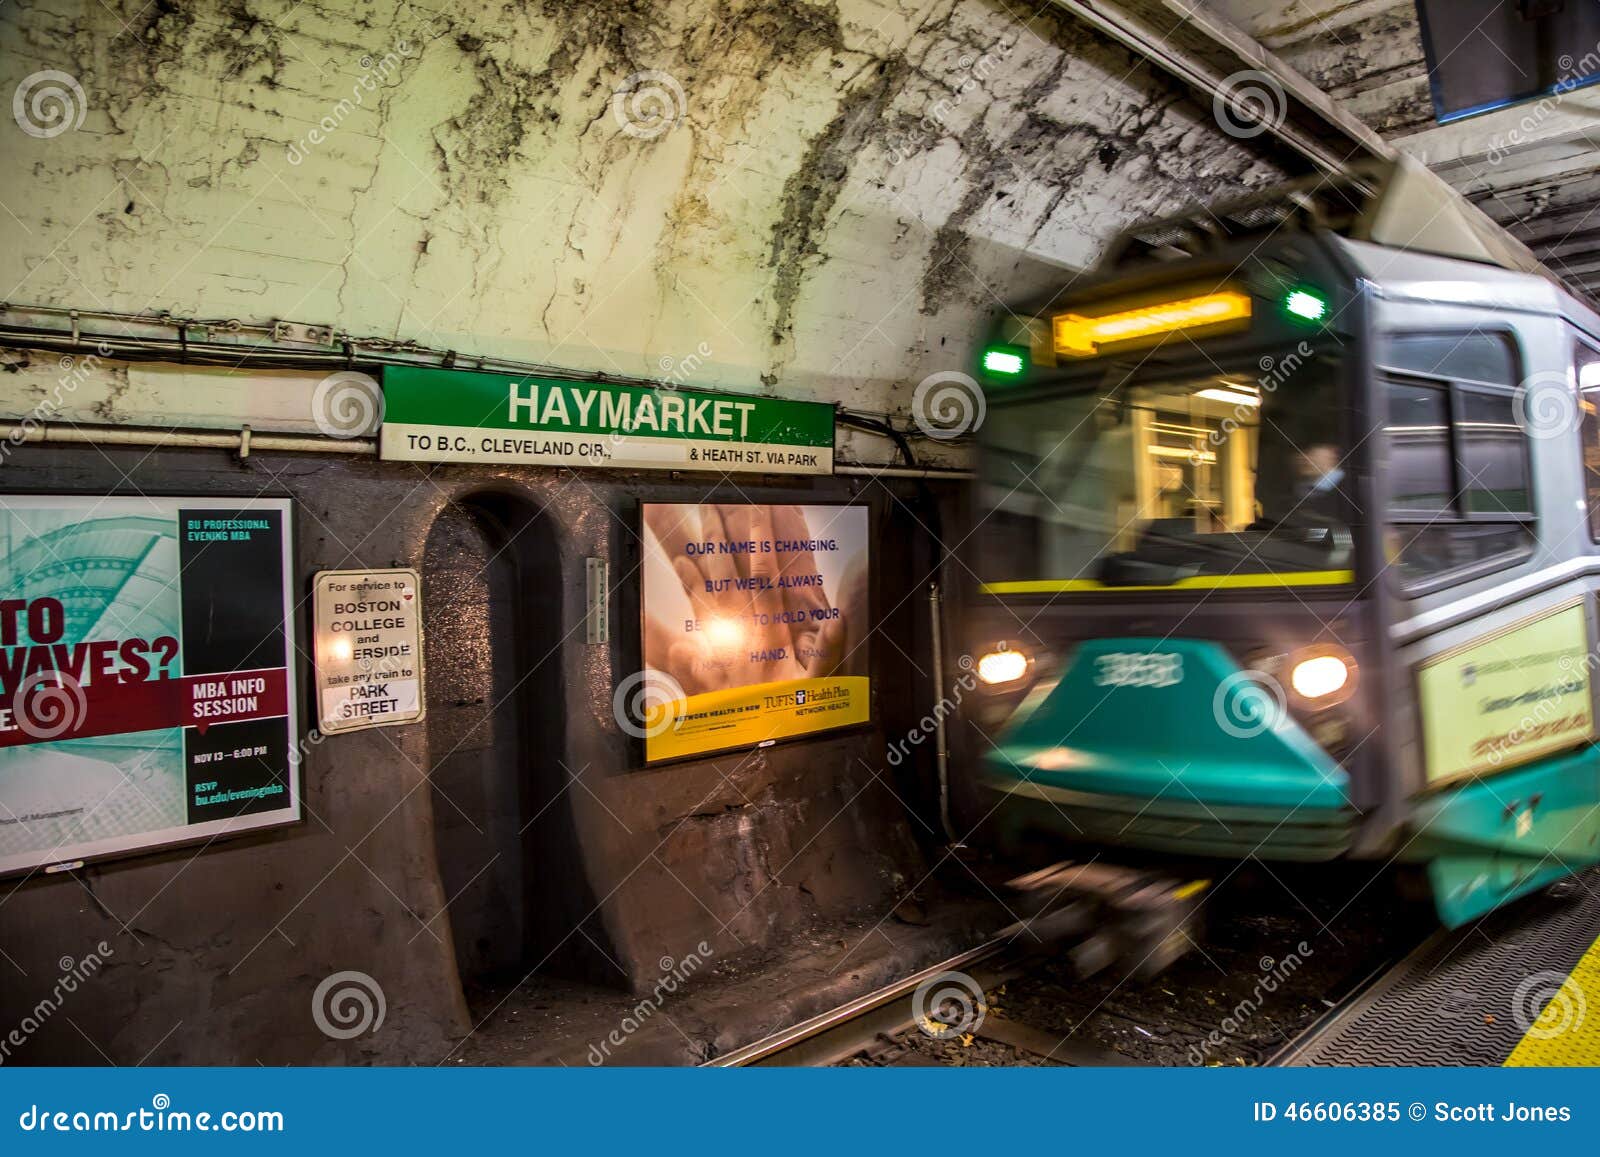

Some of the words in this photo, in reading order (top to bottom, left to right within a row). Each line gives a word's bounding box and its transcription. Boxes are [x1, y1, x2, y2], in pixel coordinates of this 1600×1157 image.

[509, 383, 756, 437] HAYMARKET
[407, 435, 431, 450] TO
[437, 437, 475, 454] B.C.,
[481, 439, 573, 457] CLEVELAND
[690, 448, 698, 460] &
[702, 449, 742, 462] HEATH
[746, 451, 764, 464] ST.
[767, 452, 784, 464] VIA
[788, 453, 818, 466] PARK
[188, 520, 200, 529] BU
[204, 519, 270, 529] PROFESSIONAL
[188, 532, 228, 541] EVENING
[231, 531, 250, 540] MBA
[686, 542, 715, 555] OUR
[719, 541, 755, 554] NAME
[760, 541, 771, 553] IS
[776, 540, 839, 552] CHANGING.
[328, 583, 346, 592] For
[350, 581, 390, 591] service
[394, 581, 406, 590] to
[705, 580, 732, 592] BUT
[736, 578, 774, 591] WE'LL
[778, 575, 824, 588] ALWAYS
[334, 600, 400, 615] BOSTON
[331, 617, 406, 632] COLLEGE
[753, 613, 769, 625] TO
[773, 611, 806, 624] HOLD
[810, 608, 839, 621] YOUR
[357, 634, 380, 644] and
[751, 648, 789, 663] HAND.
[328, 674, 350, 685] take
[352, 672, 371, 683] any
[374, 669, 398, 679] train
[401, 667, 413, 677] to
[193, 681, 227, 699] MBA
[231, 677, 265, 696] INFO
[350, 683, 389, 701] PARK
[807, 688, 833, 702] Health
[833, 686, 850, 699] Plan
[193, 696, 257, 718] SESSION
[343, 698, 398, 718] STREET
[674, 711, 708, 723] NETWORK
[710, 708, 736, 718] HEALTH
[737, 706, 744, 714] IS
[745, 704, 761, 712] NOW
[796, 705, 826, 716] NETWORK
[828, 702, 850, 712] HEALTH
[194, 753, 212, 764] NOV
[254, 745, 267, 755] PM
[195, 781, 218, 793] RSVP
[195, 784, 284, 806] bu.edu/eveningmba
